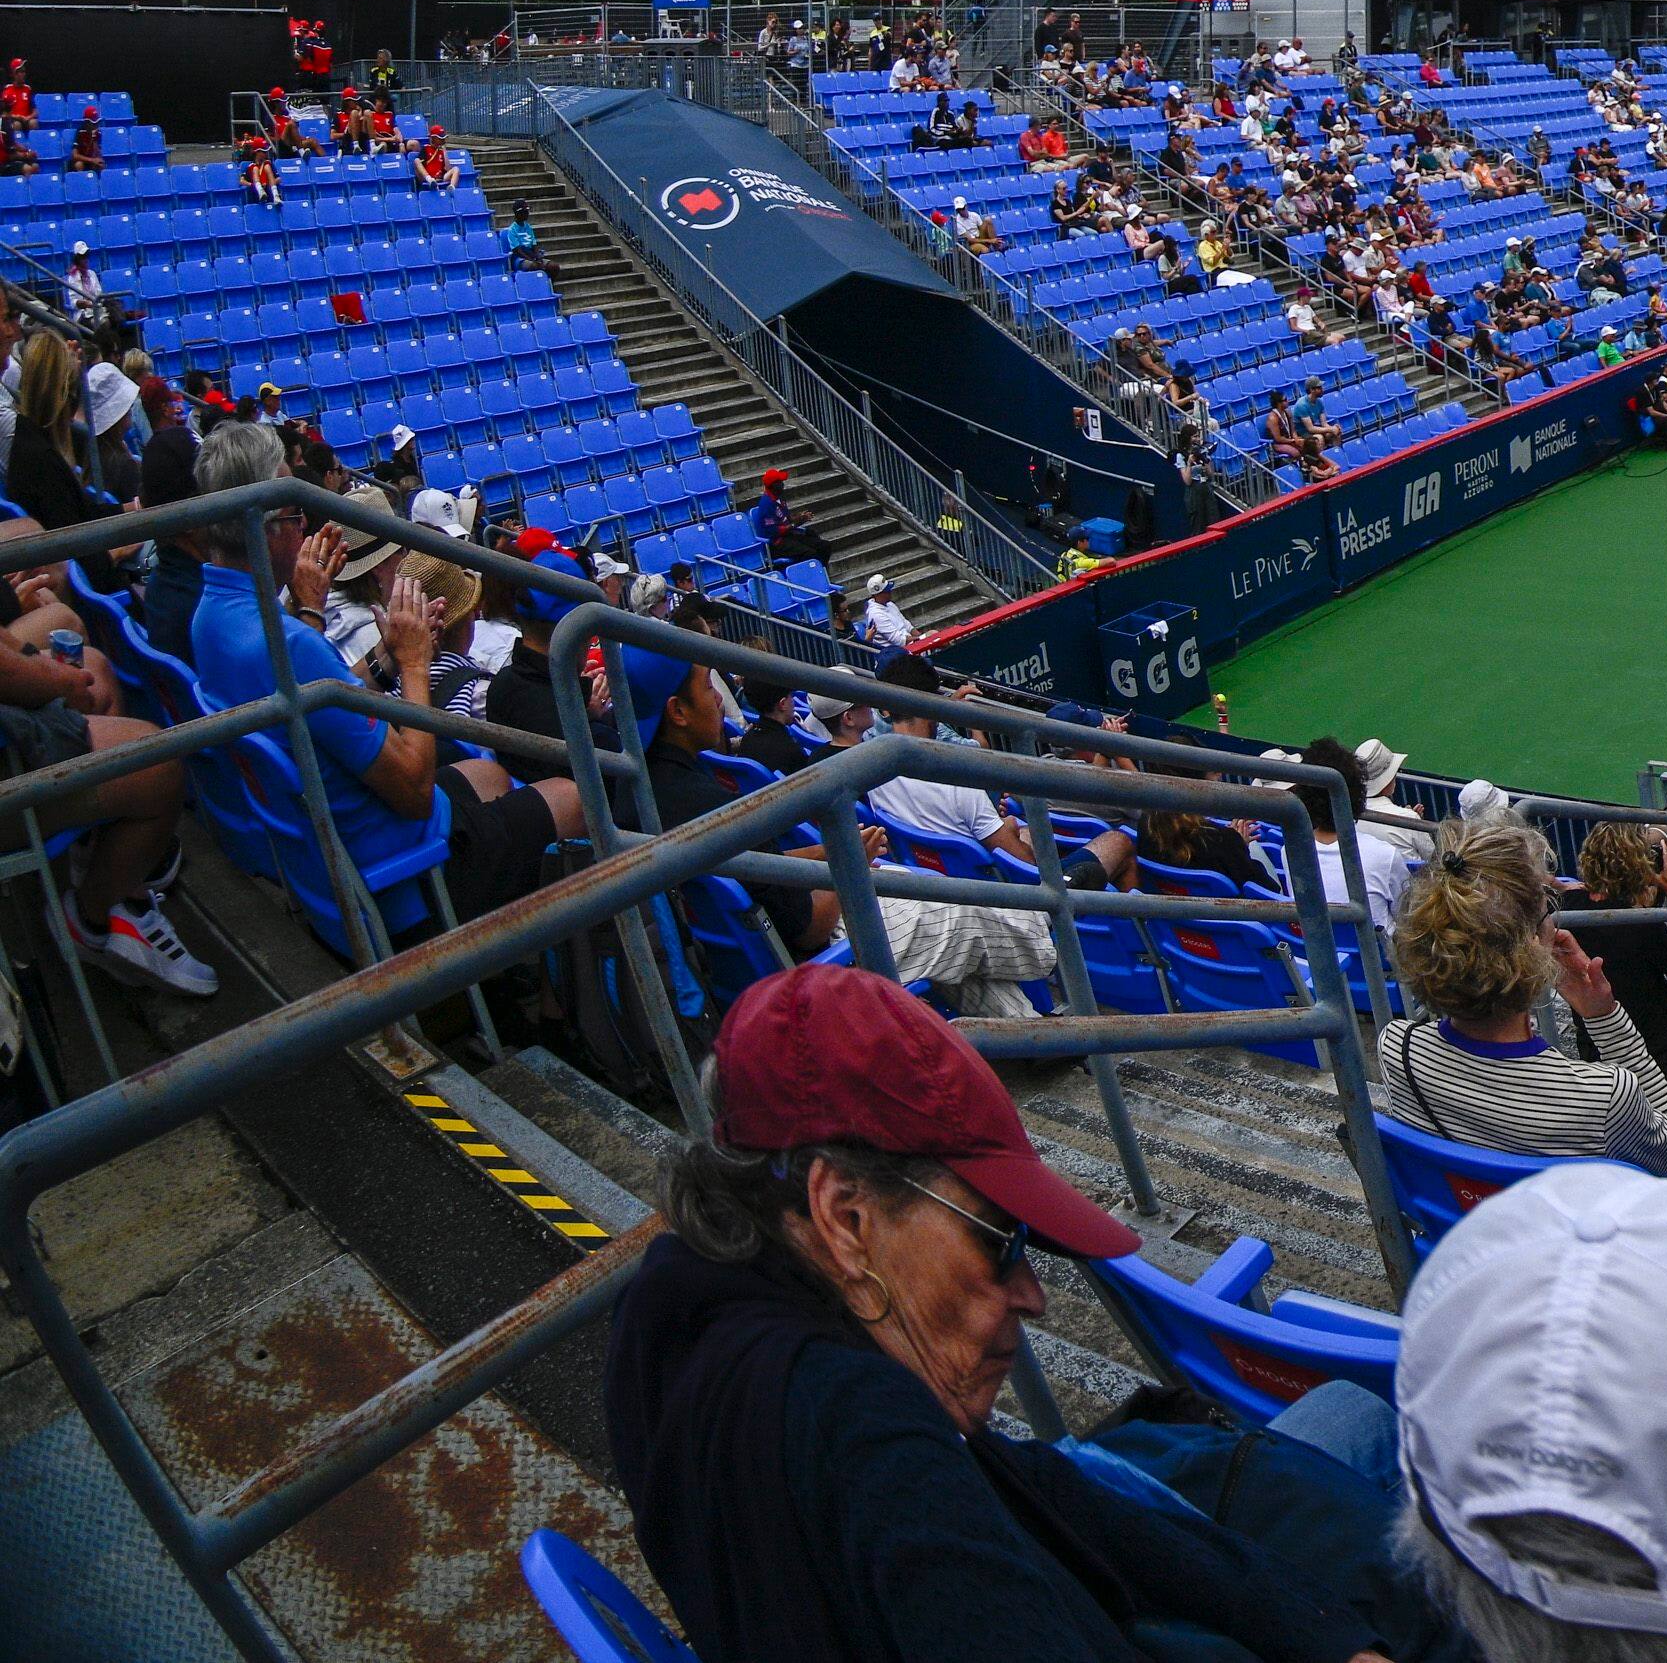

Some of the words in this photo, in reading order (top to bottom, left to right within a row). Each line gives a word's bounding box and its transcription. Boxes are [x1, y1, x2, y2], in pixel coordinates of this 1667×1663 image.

[738, 175, 809, 196] BANQUE
[749, 188, 842, 212] NATIONALE
[1535, 418, 1567, 444] BANQUE
[1535, 431, 1577, 463] NATIONALE
[1454, 448, 1499, 485] PERONI
[1403, 471, 1441, 527] IGA
[1463, 480, 1494, 500] AZZURRO
[1337, 507, 1358, 535] LA
[1340, 516, 1392, 560] PRESSE
[1192, 608, 1199, 621] 2
[1147, 651, 1171, 694] G
[1178, 636, 1201, 679] G
[1110, 659, 1139, 698] G
[1476, 1441, 1524, 1464] new
